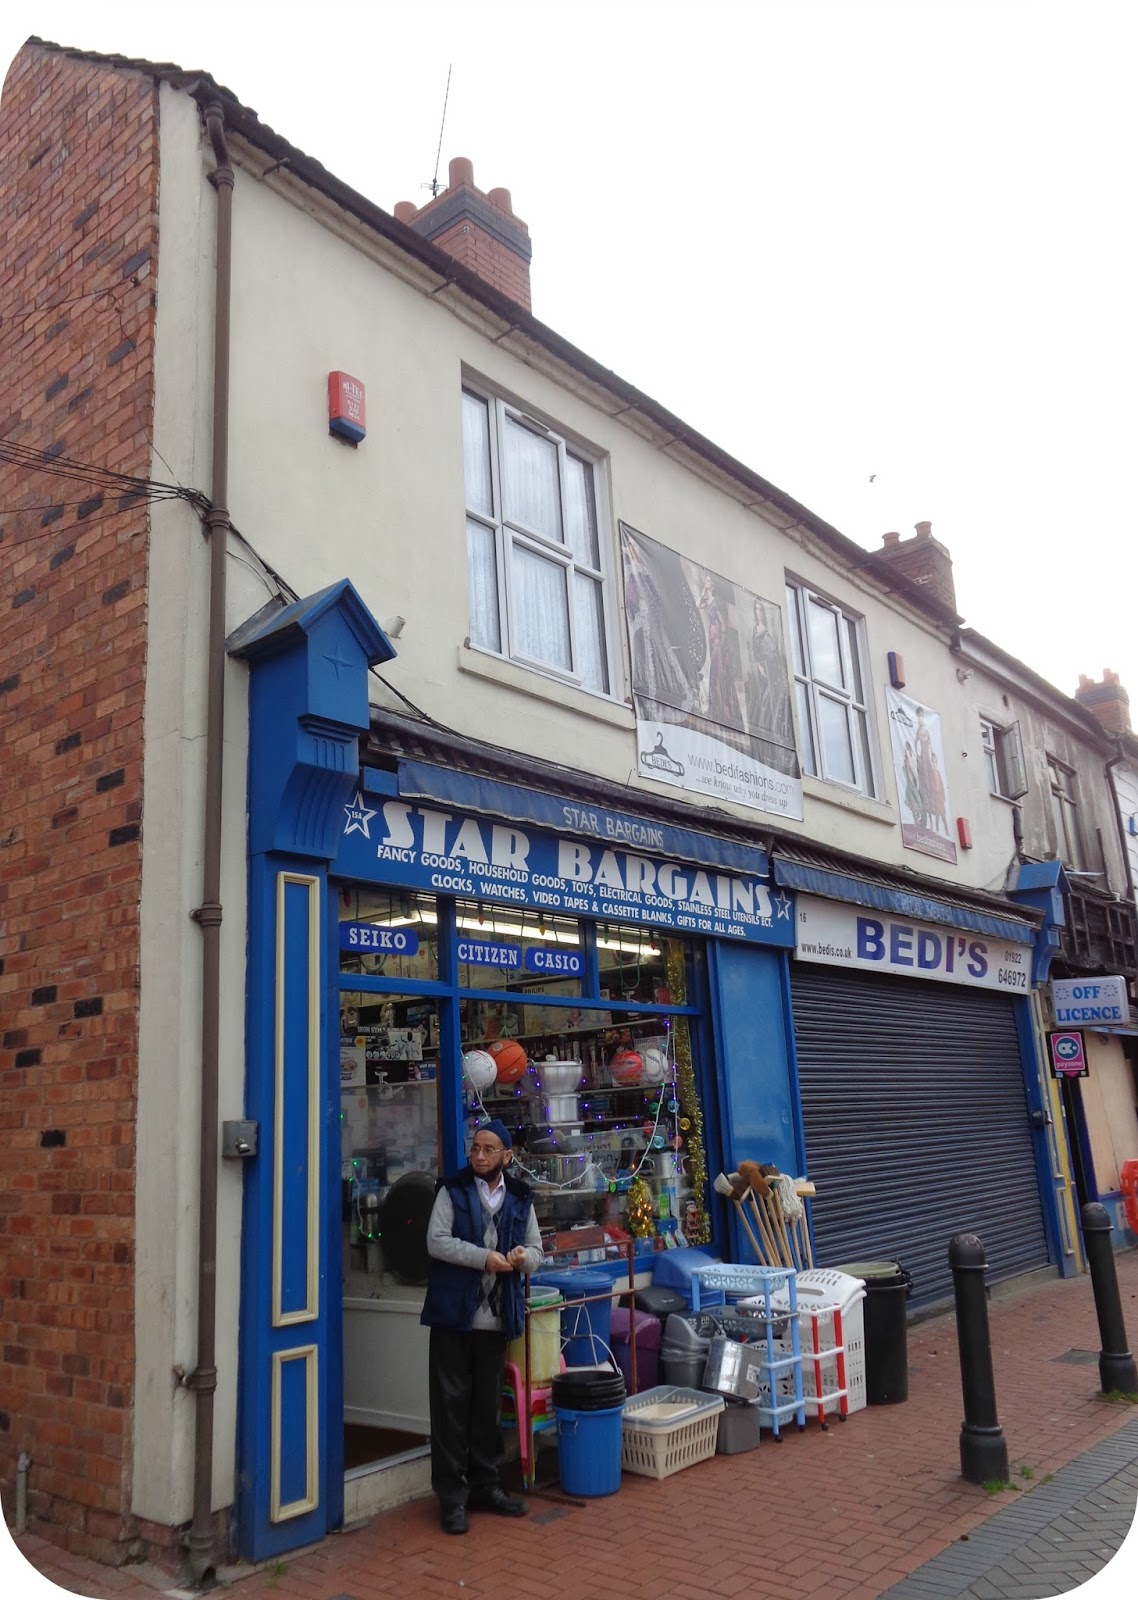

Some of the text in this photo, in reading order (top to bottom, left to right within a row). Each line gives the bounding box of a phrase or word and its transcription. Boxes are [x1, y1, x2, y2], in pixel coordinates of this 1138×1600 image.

[651, 755, 673, 770] BEDI'S
[688, 754, 794, 796] www.bedifashions.com
[714, 779, 731, 790] know
[733, 784, 747, 798] why
[748, 789, 760, 801] you
[761, 790, 778, 805] dress
[779, 799, 788, 809] up
[563, 806, 664, 847] STAR BARGAINS
[382, 801, 773, 918] STAR BARGAINS
[377, 845, 416, 863] FANCY
[421, 853, 465, 874] GOODS,
[469, 862, 529, 883] HOUSEHOLD
[532, 873, 568, 893] GOODS,
[572, 882, 597, 898] TOYS,
[599, 886, 642, 903] ELECTRICAL
[645, 895, 675, 911] GOODS,
[677, 900, 712, 916] STAINLESS
[714, 907, 731, 920] STEEL
[733, 910, 760, 926] UTENSILS
[431, 874, 746, 937] CLOCKS, WATCHES, VIDEO TAPES & CASSETTE BLANKS, GIFTS FOR ALL AGES.
[799, 912, 807, 923] 16
[350, 927, 406, 949] SEIKO
[856, 916, 988, 979] BEDI'S
[458, 944, 518, 965] CITIZEN
[801, 942, 852, 959] www.bedis.co.uk
[1004, 950, 1022, 964] 01922
[534, 952, 580, 971] CASIO
[998, 967, 1027, 988] 646972
[1072, 985, 1101, 1000] OFF
[1056, 1005, 1122, 1022] LICENCE
